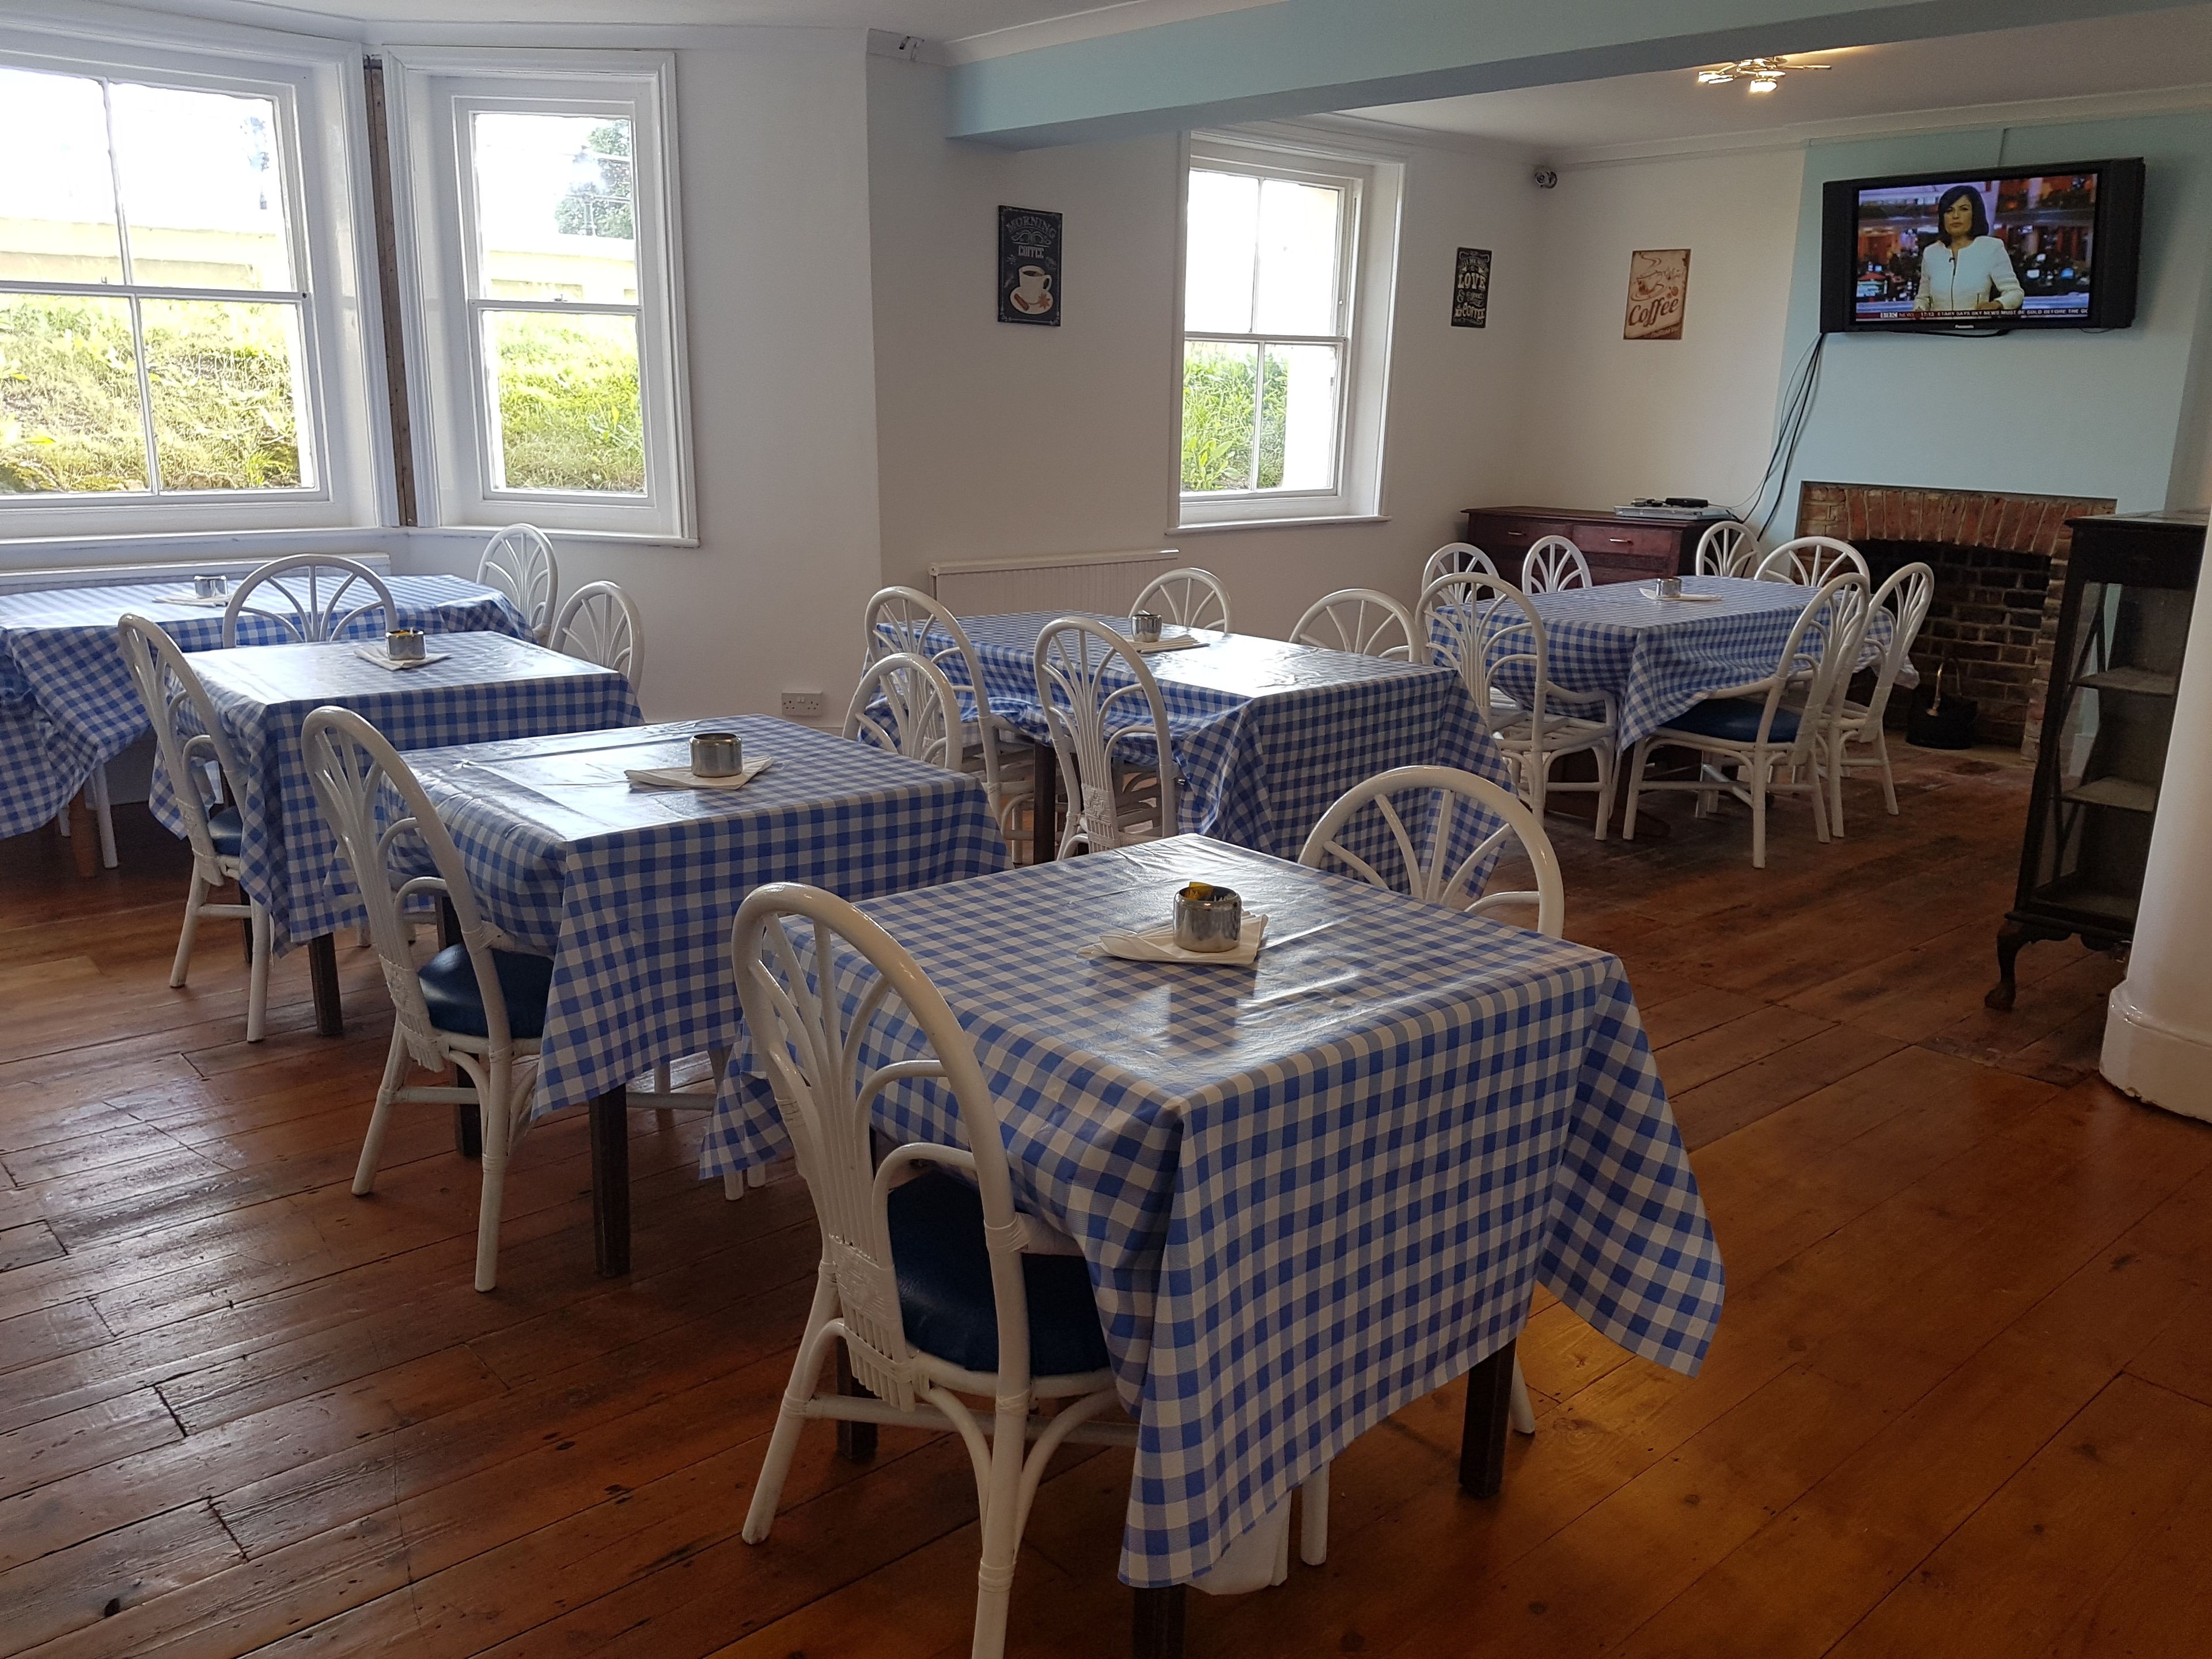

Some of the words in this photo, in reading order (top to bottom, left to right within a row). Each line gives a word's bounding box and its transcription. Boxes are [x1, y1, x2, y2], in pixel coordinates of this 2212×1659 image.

[1005, 216, 1056, 239] MORNING
[1018, 245, 1044, 259] COFFEE
[1457, 272, 1486, 290] LOVE
[1628, 297, 1679, 327] Coffee
